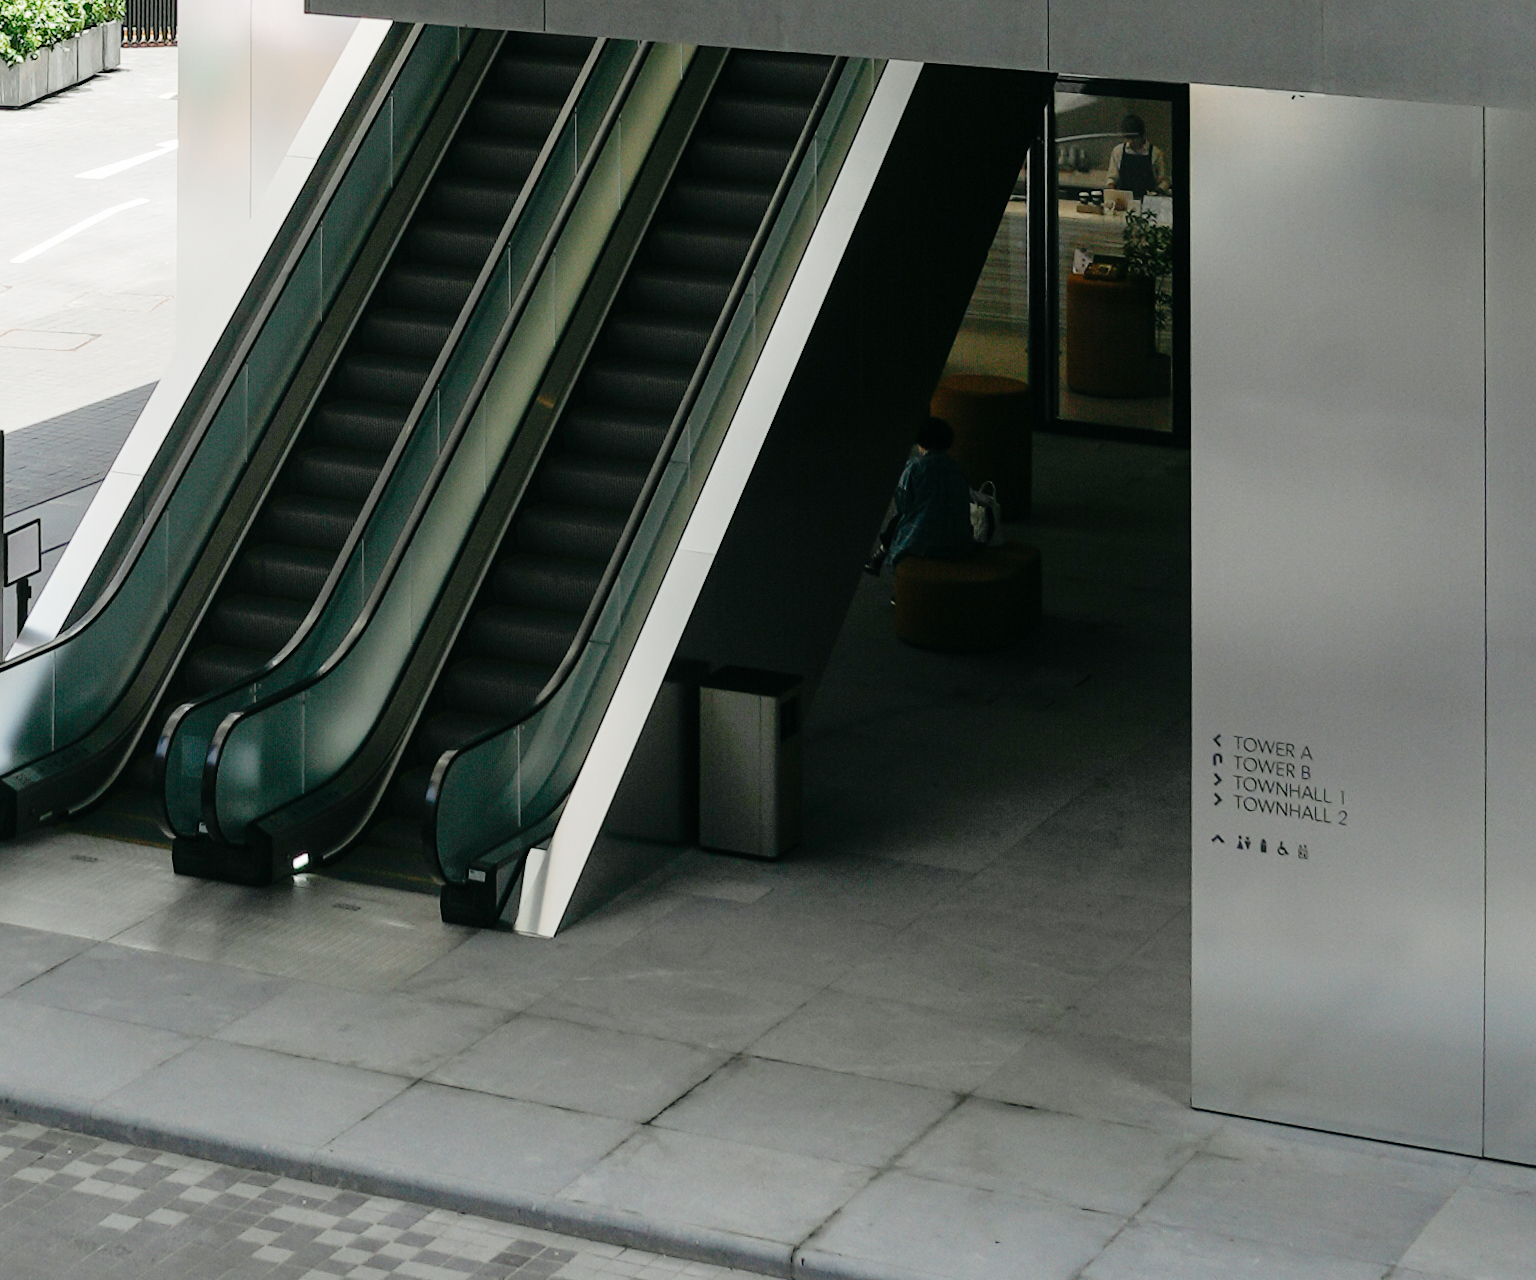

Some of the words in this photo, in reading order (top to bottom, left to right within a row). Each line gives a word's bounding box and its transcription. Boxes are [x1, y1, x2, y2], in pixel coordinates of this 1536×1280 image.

[1233, 735, 1295, 758] TOWER
[1301, 746, 1313, 760] A
[1233, 755, 1295, 778] TOWER
[1301, 765, 1311, 780] B
[1233, 775, 1332, 804] TOWNHALL
[1340, 790, 1345, 805] 1
[1233, 794, 1332, 824] TOWNHALL
[1338, 810, 1348, 826] 2
